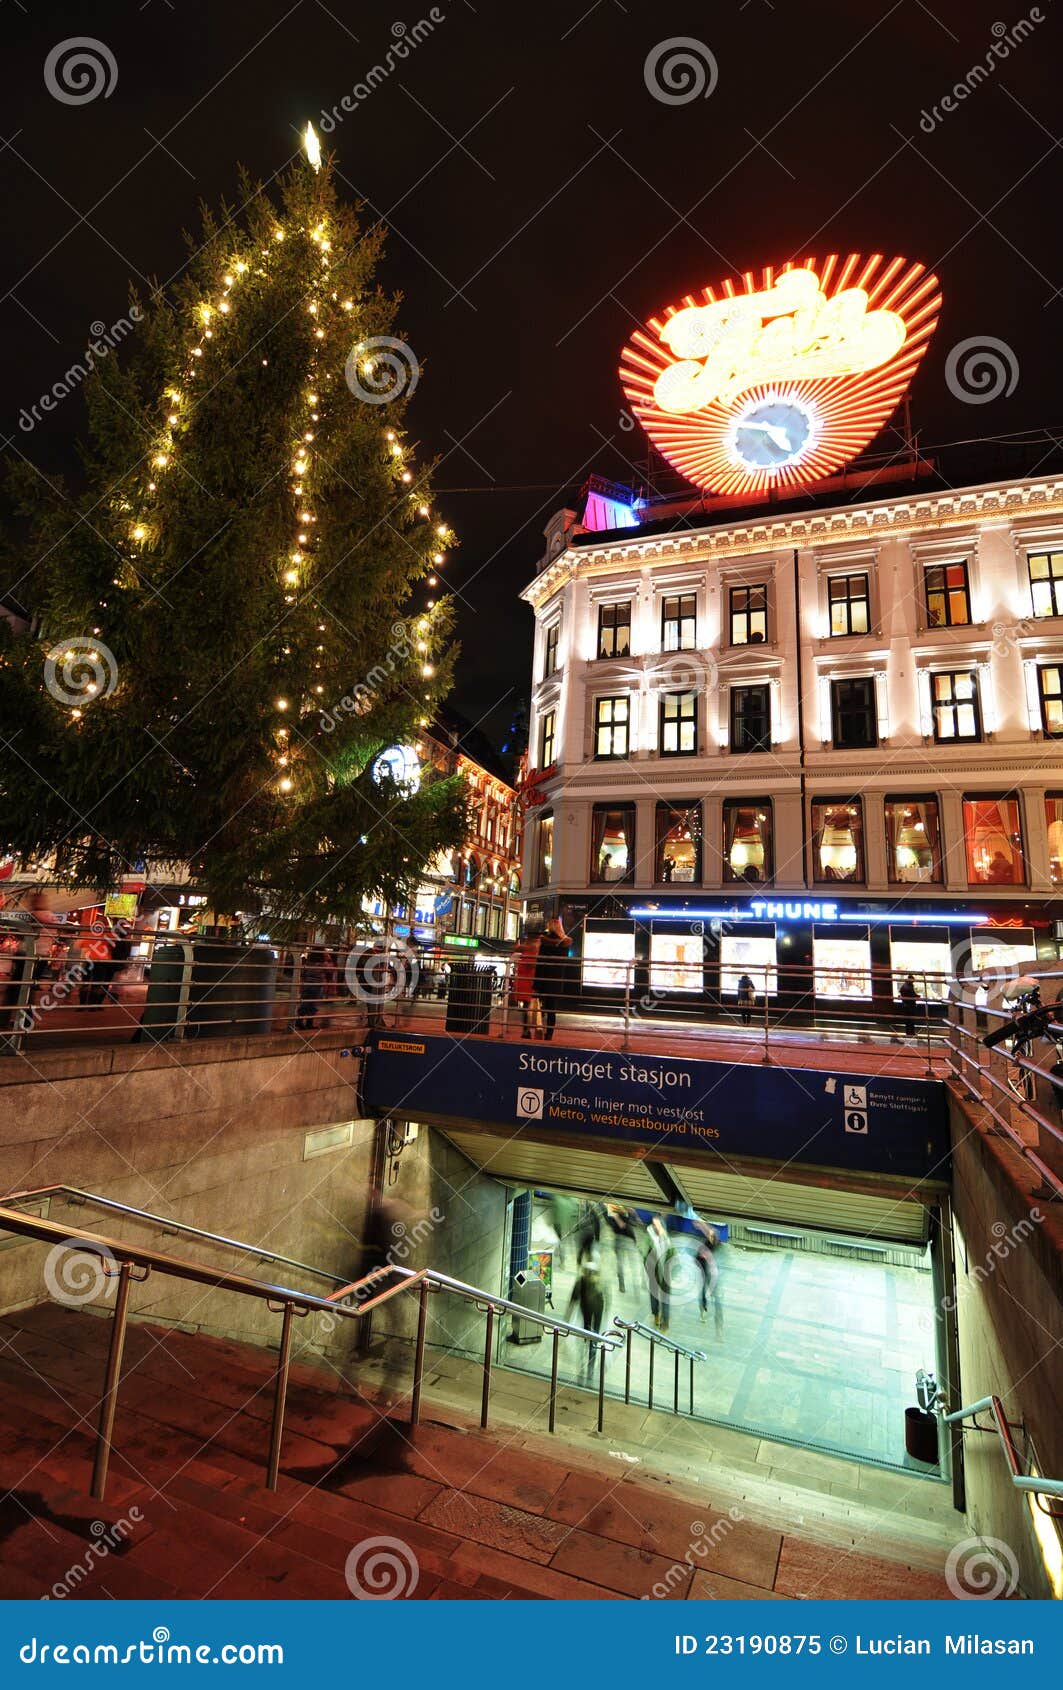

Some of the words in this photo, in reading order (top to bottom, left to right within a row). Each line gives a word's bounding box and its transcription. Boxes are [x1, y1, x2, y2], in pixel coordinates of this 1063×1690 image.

[751, 902, 838, 920] THUNE
[519, 1053, 613, 1082] Stortinget
[620, 1064, 691, 1090] stasjon
[550, 1092, 590, 1109] T-bane,
[594, 1096, 625, 1112] linjer
[628, 1102, 652, 1115] mot
[549, 1105, 587, 1123] Metro,
[591, 1114, 686, 1135] west/eastbound
[690, 1124, 720, 1139] lines
